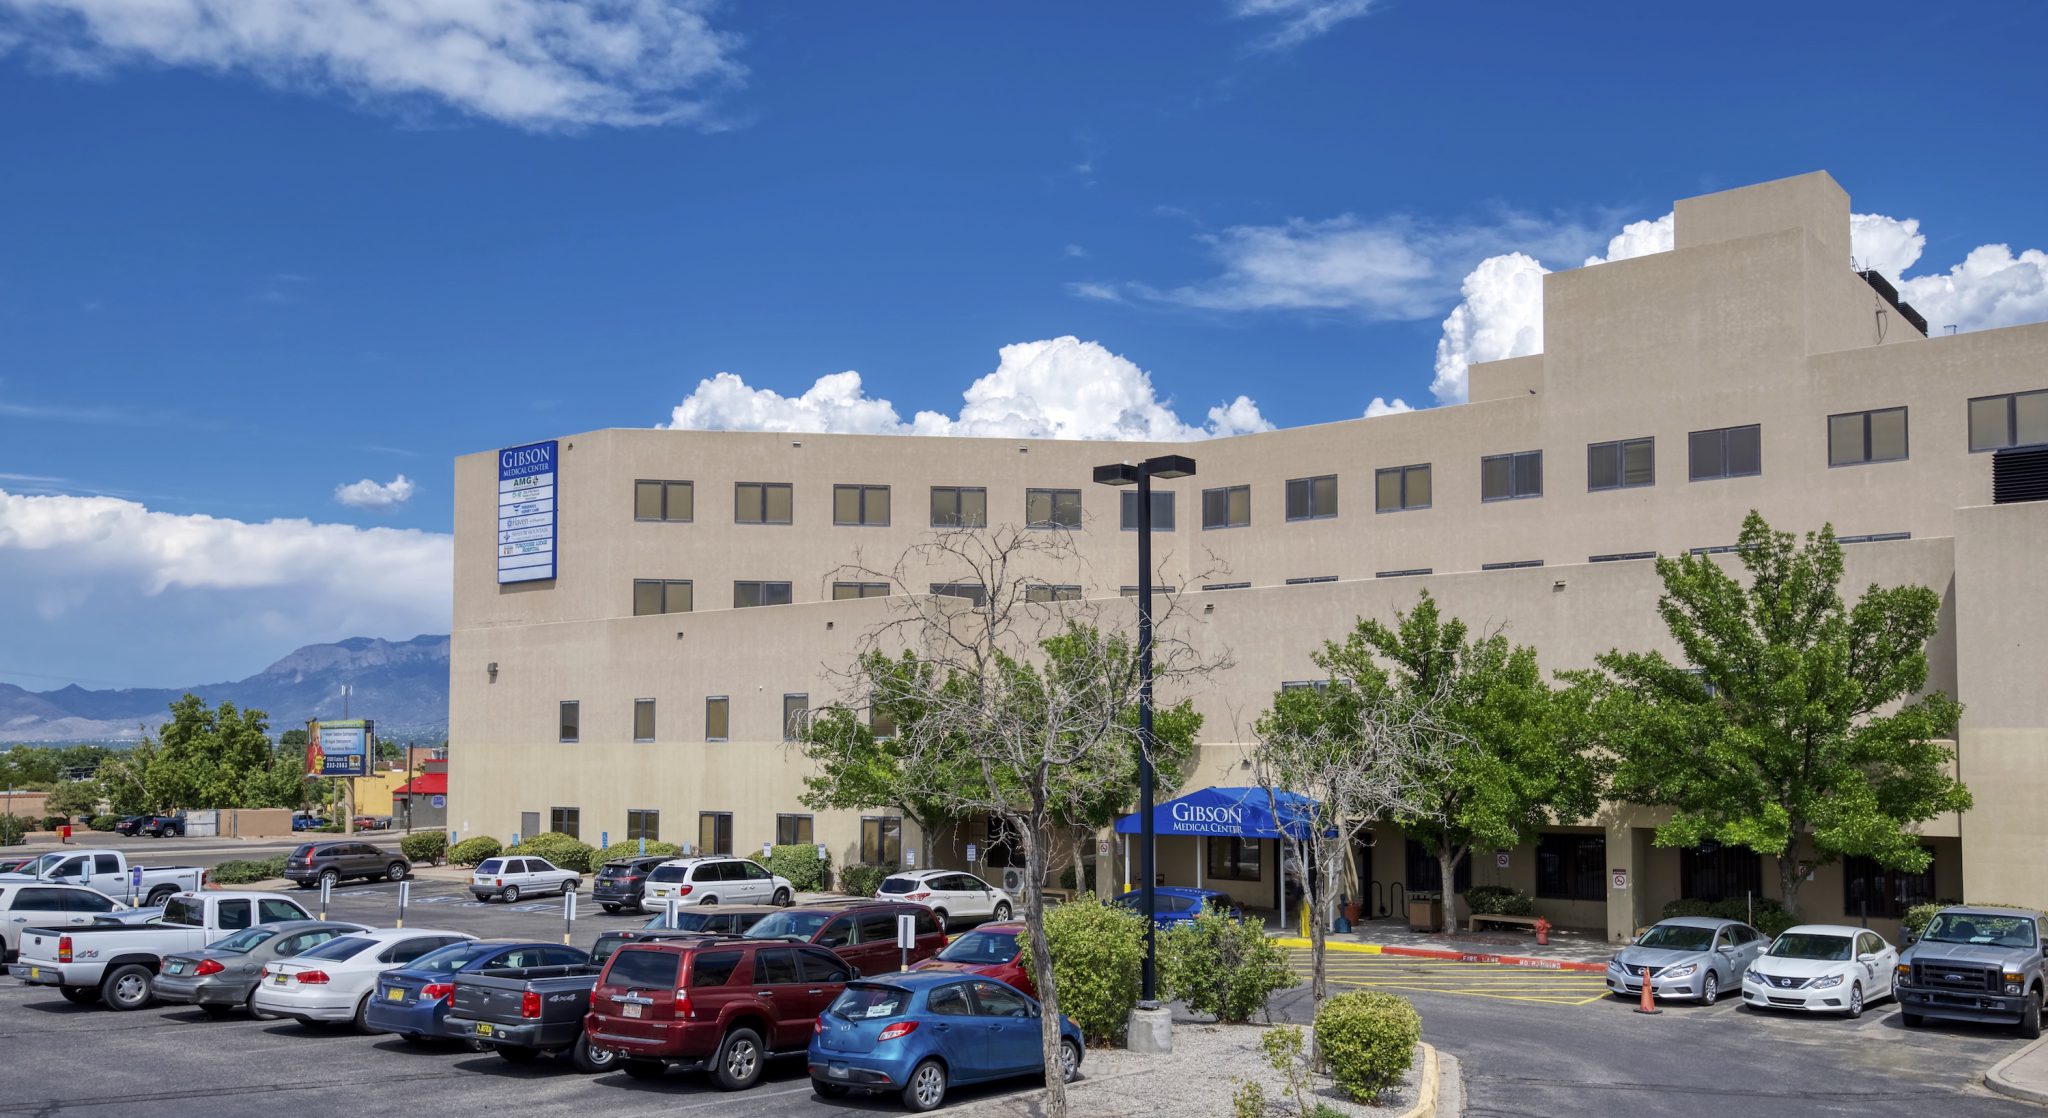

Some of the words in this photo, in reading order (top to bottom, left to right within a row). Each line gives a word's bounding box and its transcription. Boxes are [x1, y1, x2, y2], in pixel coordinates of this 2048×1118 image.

[502, 446, 550, 468] GIBSON
[503, 467, 527, 477] MEDICAL
[527, 463, 549, 473] CENTER
[513, 477, 532, 486] AMG
[1172, 802, 1243, 824] GIBSON
[1173, 822, 1210, 832] MEDICAL
[1210, 823, 1243, 834] CENTER
